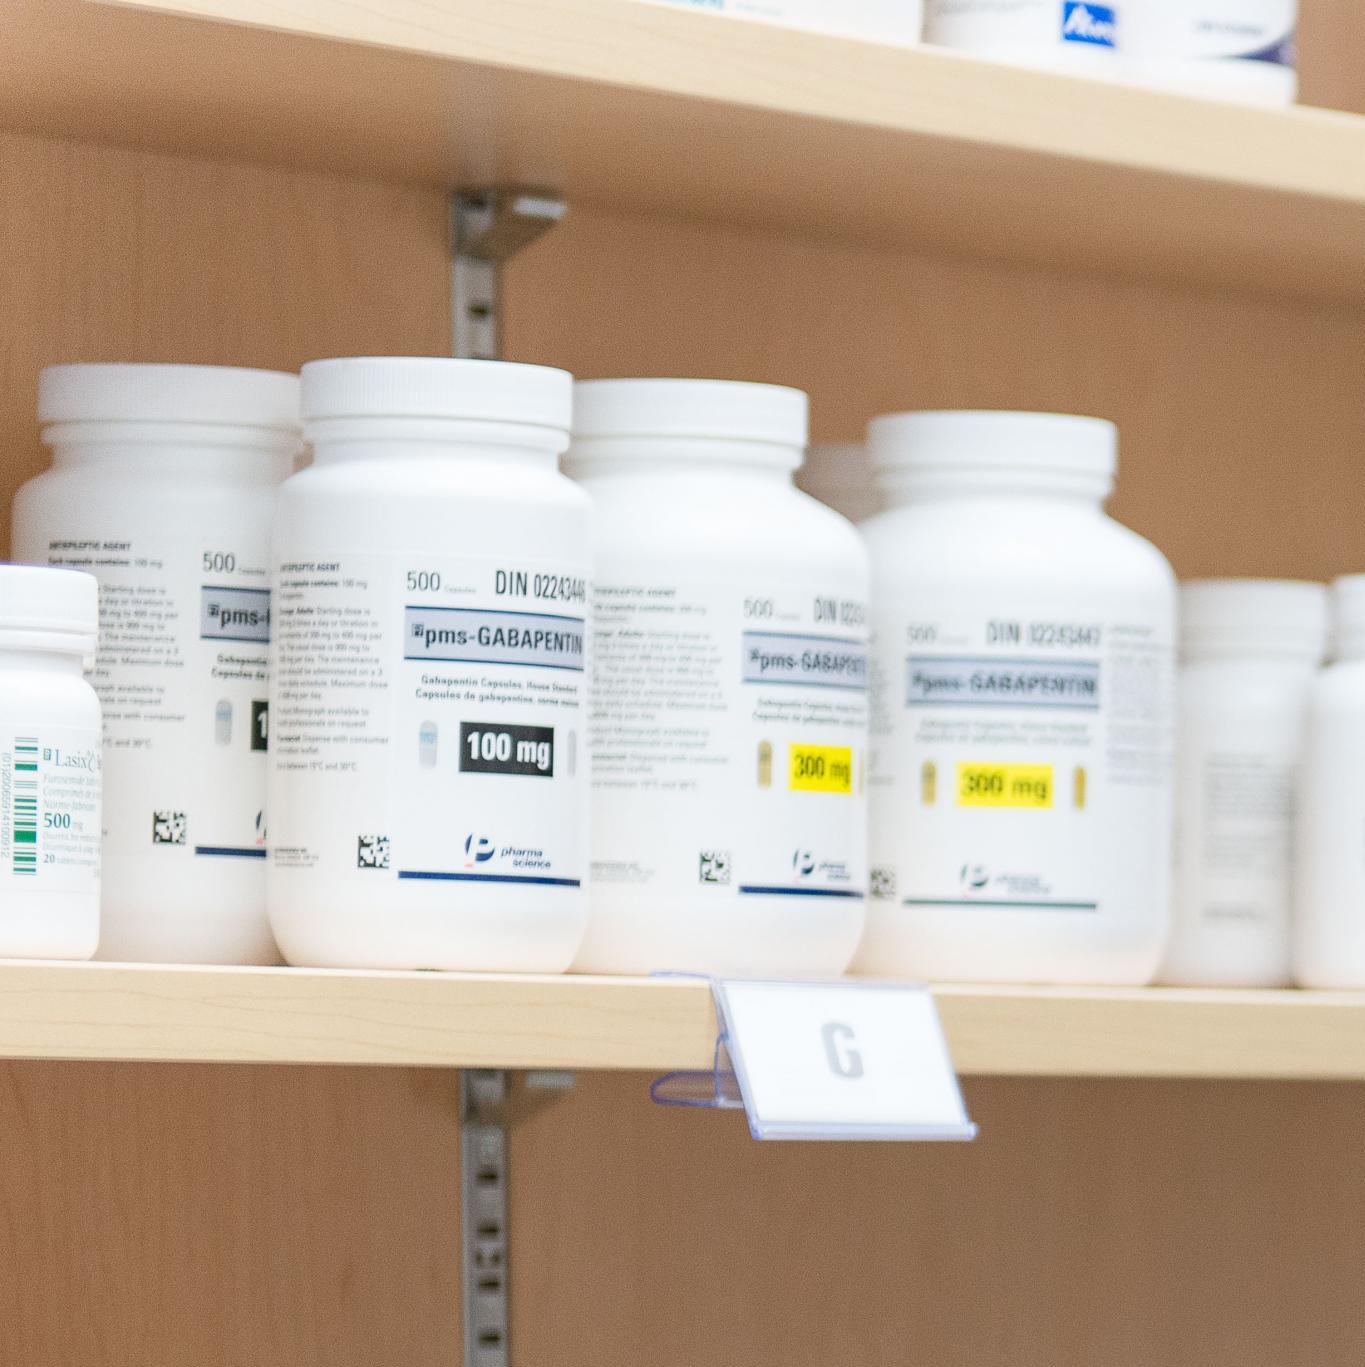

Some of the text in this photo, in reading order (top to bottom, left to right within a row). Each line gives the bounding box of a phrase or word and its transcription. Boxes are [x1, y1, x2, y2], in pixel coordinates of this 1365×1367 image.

[203, 552, 235, 574] 500
[407, 571, 440, 592] 500
[496, 570, 527, 597] DIN
[744, 598, 773, 619] 500
[426, 626, 583, 655] pms-GABAPENTIN
[467, 731, 551, 771] 100 mg
[795, 754, 851, 786] 300 mg
[963, 774, 1049, 803] 300 mg
[44, 813, 71, 829] 500
[501, 847, 543, 858] pharma
[513, 858, 552, 869] science
[820, 1021, 865, 1079] G
